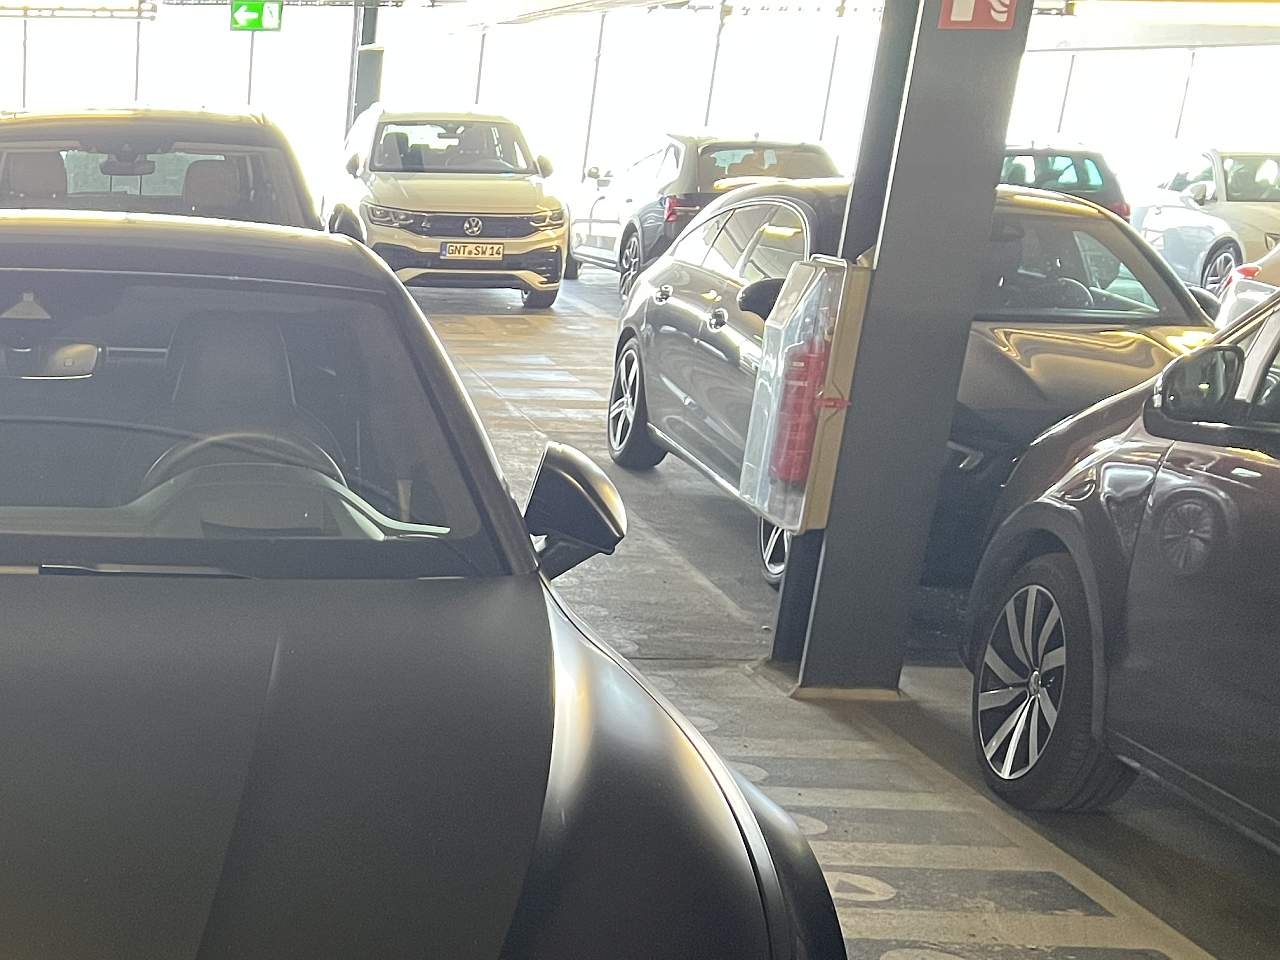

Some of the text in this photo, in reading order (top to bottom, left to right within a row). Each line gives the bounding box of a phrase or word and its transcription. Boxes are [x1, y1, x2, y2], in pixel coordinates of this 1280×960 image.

[447, 244, 502, 256] GNT SW 14
